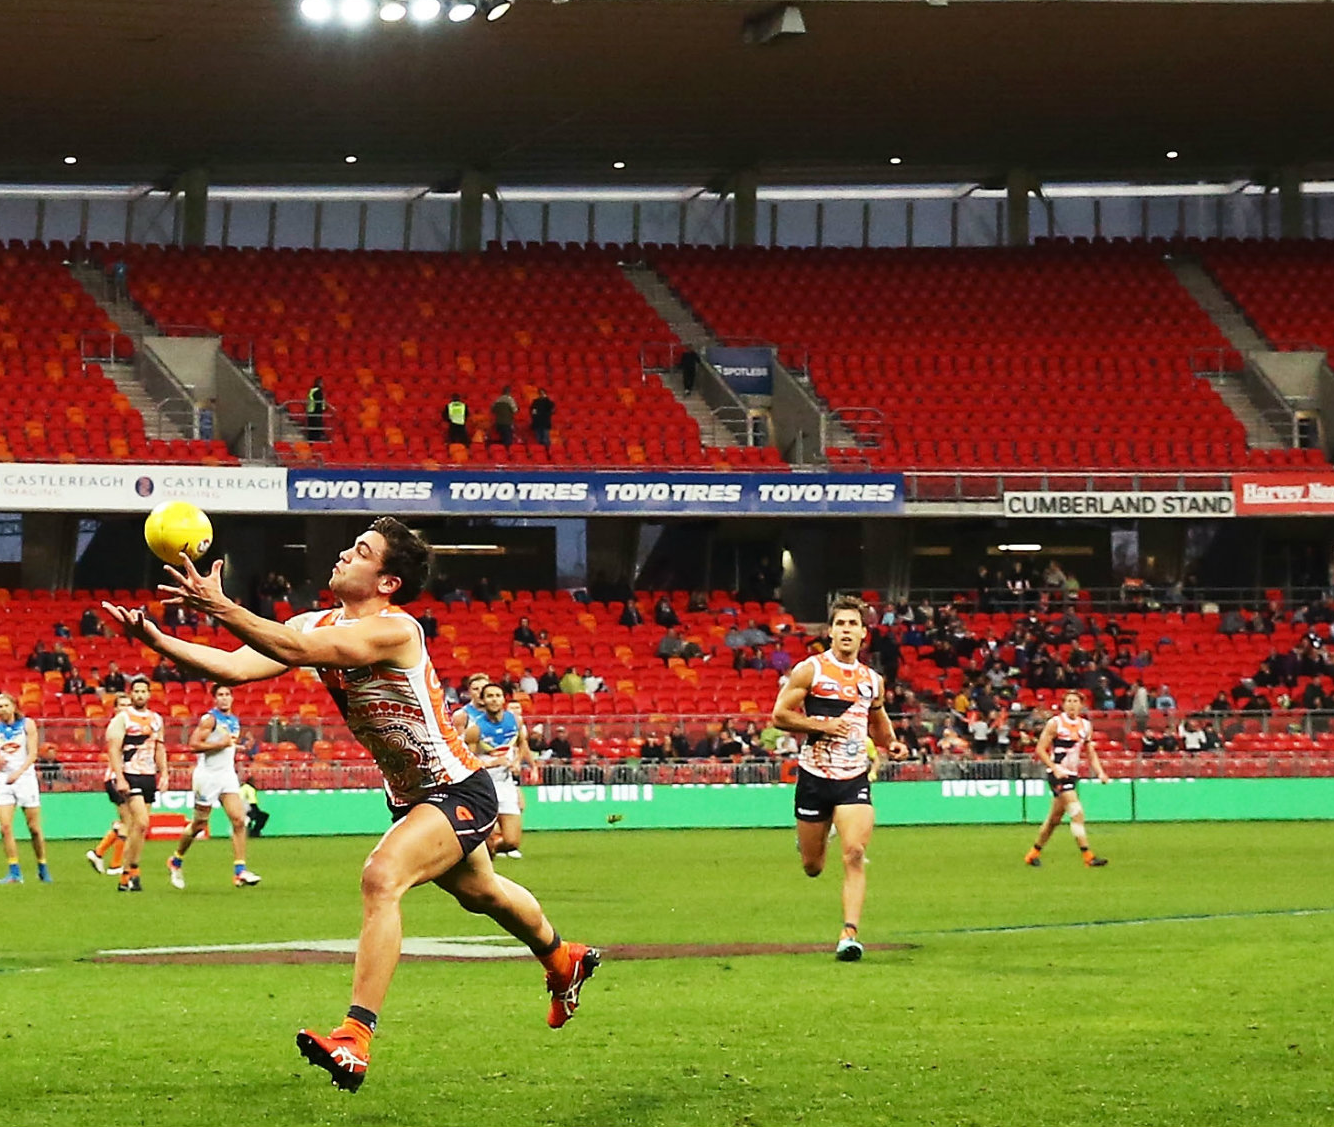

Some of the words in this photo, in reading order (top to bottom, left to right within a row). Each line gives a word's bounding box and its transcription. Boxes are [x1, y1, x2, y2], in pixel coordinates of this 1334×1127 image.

[3, 474, 124, 488] CASTLEREAGH
[162, 476, 283, 490] CASTLEREAGH
[294, 481, 360, 499] TOYO
[361, 481, 433, 499] TIRES
[449, 482, 515, 500] TOYO
[516, 482, 588, 501] TIRES
[605, 483, 670, 501] TOYO
[671, 484, 742, 502] TIRES
[758, 484, 823, 502] TOYO
[824, 484, 895, 502] TIRES
[1008, 496, 1156, 514] CUMBERLAND
[1163, 496, 1232, 514] STAND
